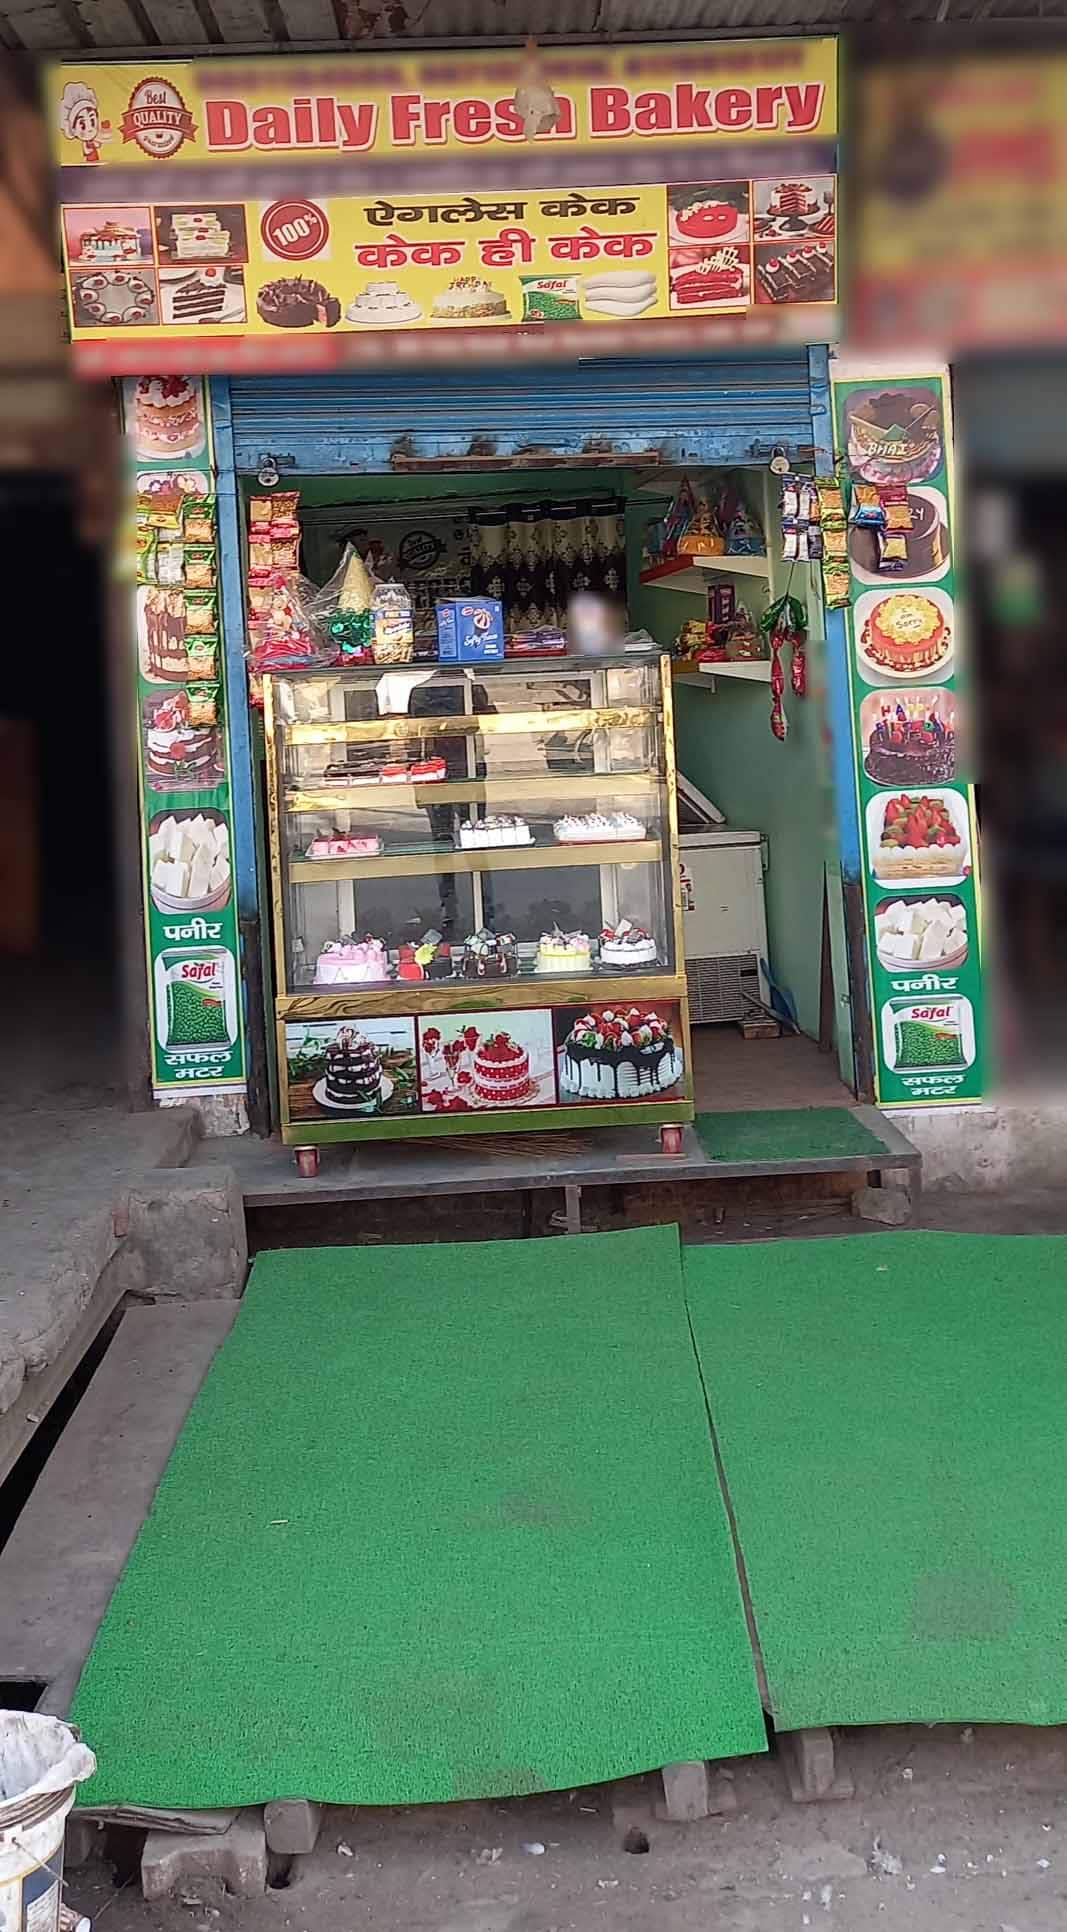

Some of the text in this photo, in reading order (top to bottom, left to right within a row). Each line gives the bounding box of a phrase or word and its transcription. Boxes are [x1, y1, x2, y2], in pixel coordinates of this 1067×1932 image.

[133, 109, 183, 128] QUALITY
[204, 96, 377, 149] Daily
[589, 83, 823, 134] Bakery
[362, 192, 641, 227] ऐगलेस केक
[271, 212, 318, 247] 100%
[354, 225, 658, 269] केक ही केक
[536, 279, 568, 292] Safal
[163, 918, 222, 940] पनीर
[182, 962, 216, 981] Safal
[891, 974, 958, 992] पनीर
[912, 1006, 950, 1020] Safal
[164, 1050, 232, 1066] सफल
[174, 1065, 224, 1080] मटर
[902, 1074, 963, 1086] सफल
[912, 1086, 957, 1096] मटर
